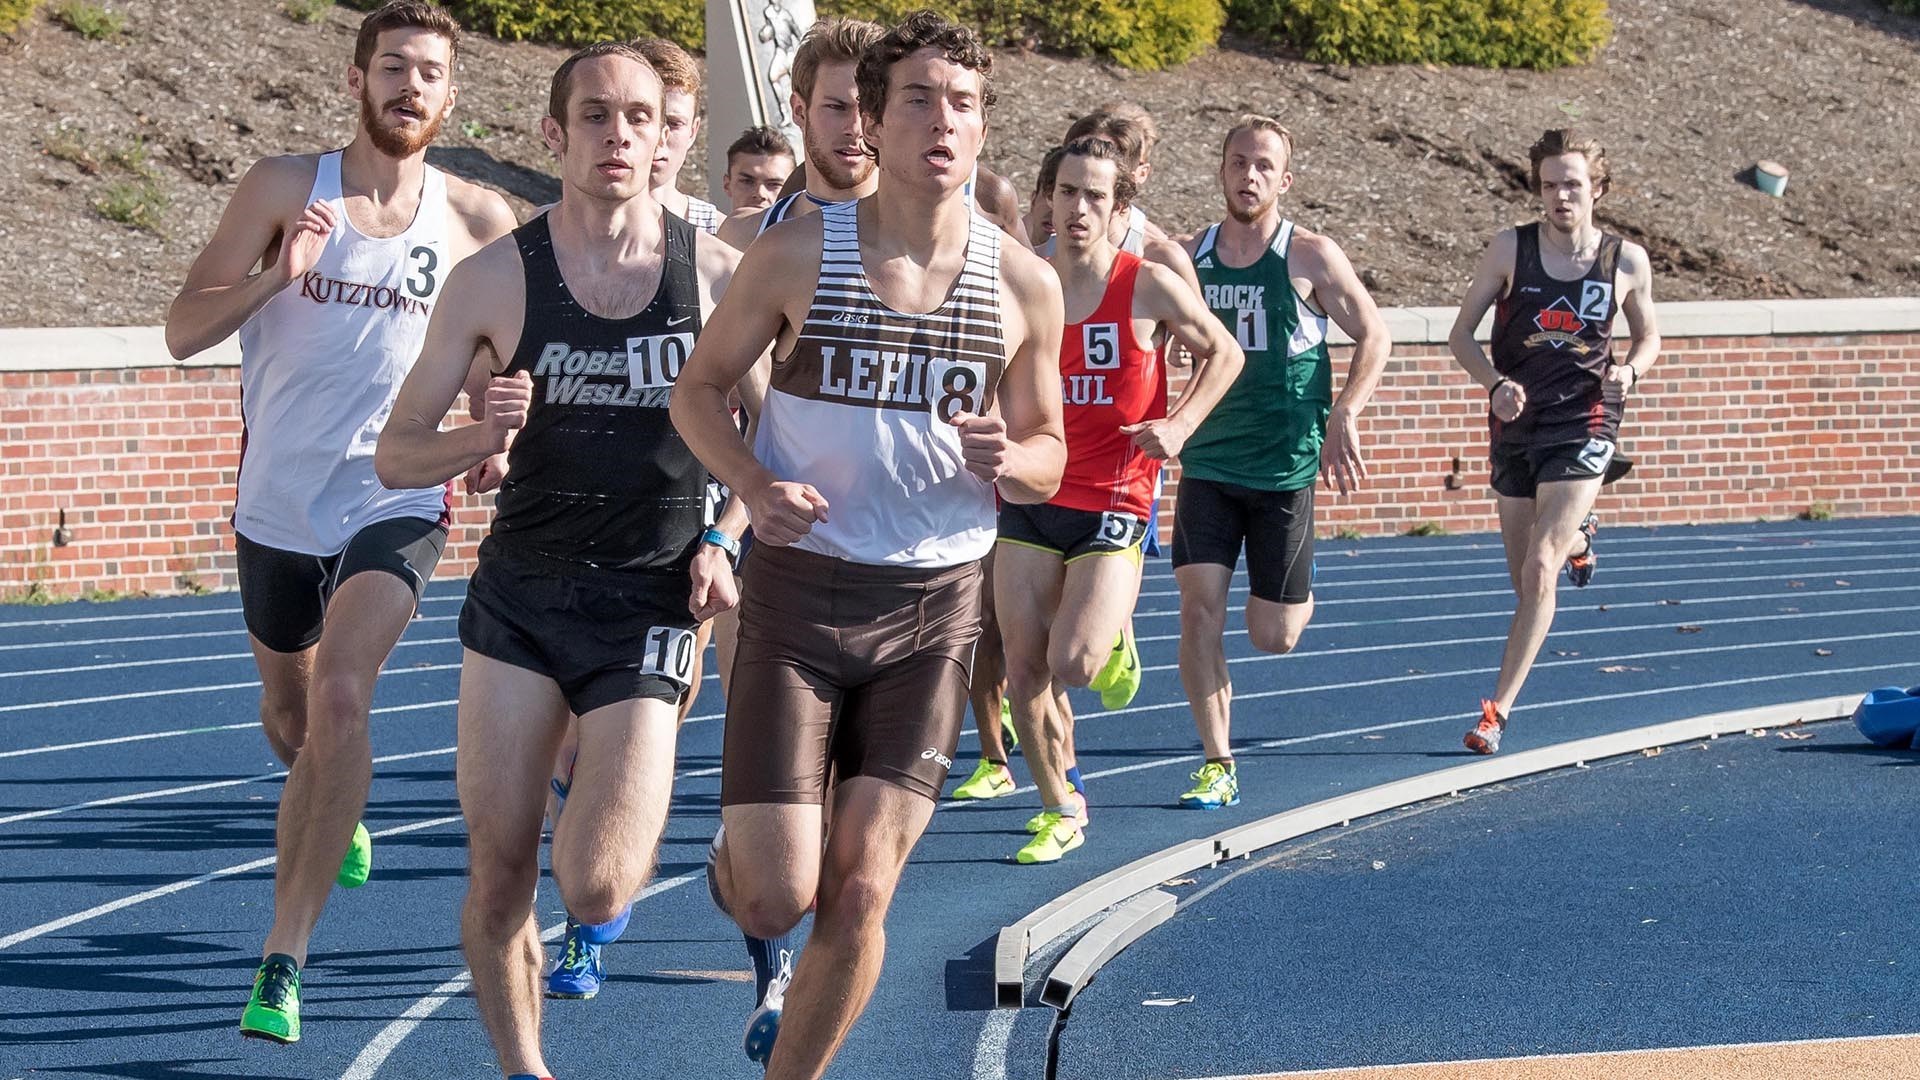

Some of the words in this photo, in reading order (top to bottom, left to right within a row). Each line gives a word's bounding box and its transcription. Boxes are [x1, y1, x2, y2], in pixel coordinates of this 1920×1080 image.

[406, 246, 438, 298] 3
[300, 271, 430, 316] KUTZTOWN
[1204, 285, 1265, 309] ROCK
[1583, 285, 1606, 317] 2
[1241, 315, 1257, 348] 1
[1539, 309, 1582, 331] UL
[632, 337, 687, 385] 10
[1088, 326, 1113, 366] 5
[819, 346, 934, 404] LEHI
[937, 366, 977, 424] 8
[1583, 442, 1608, 469] 2
[1104, 514, 1128, 541] 5
[652, 629, 692, 678] 10
